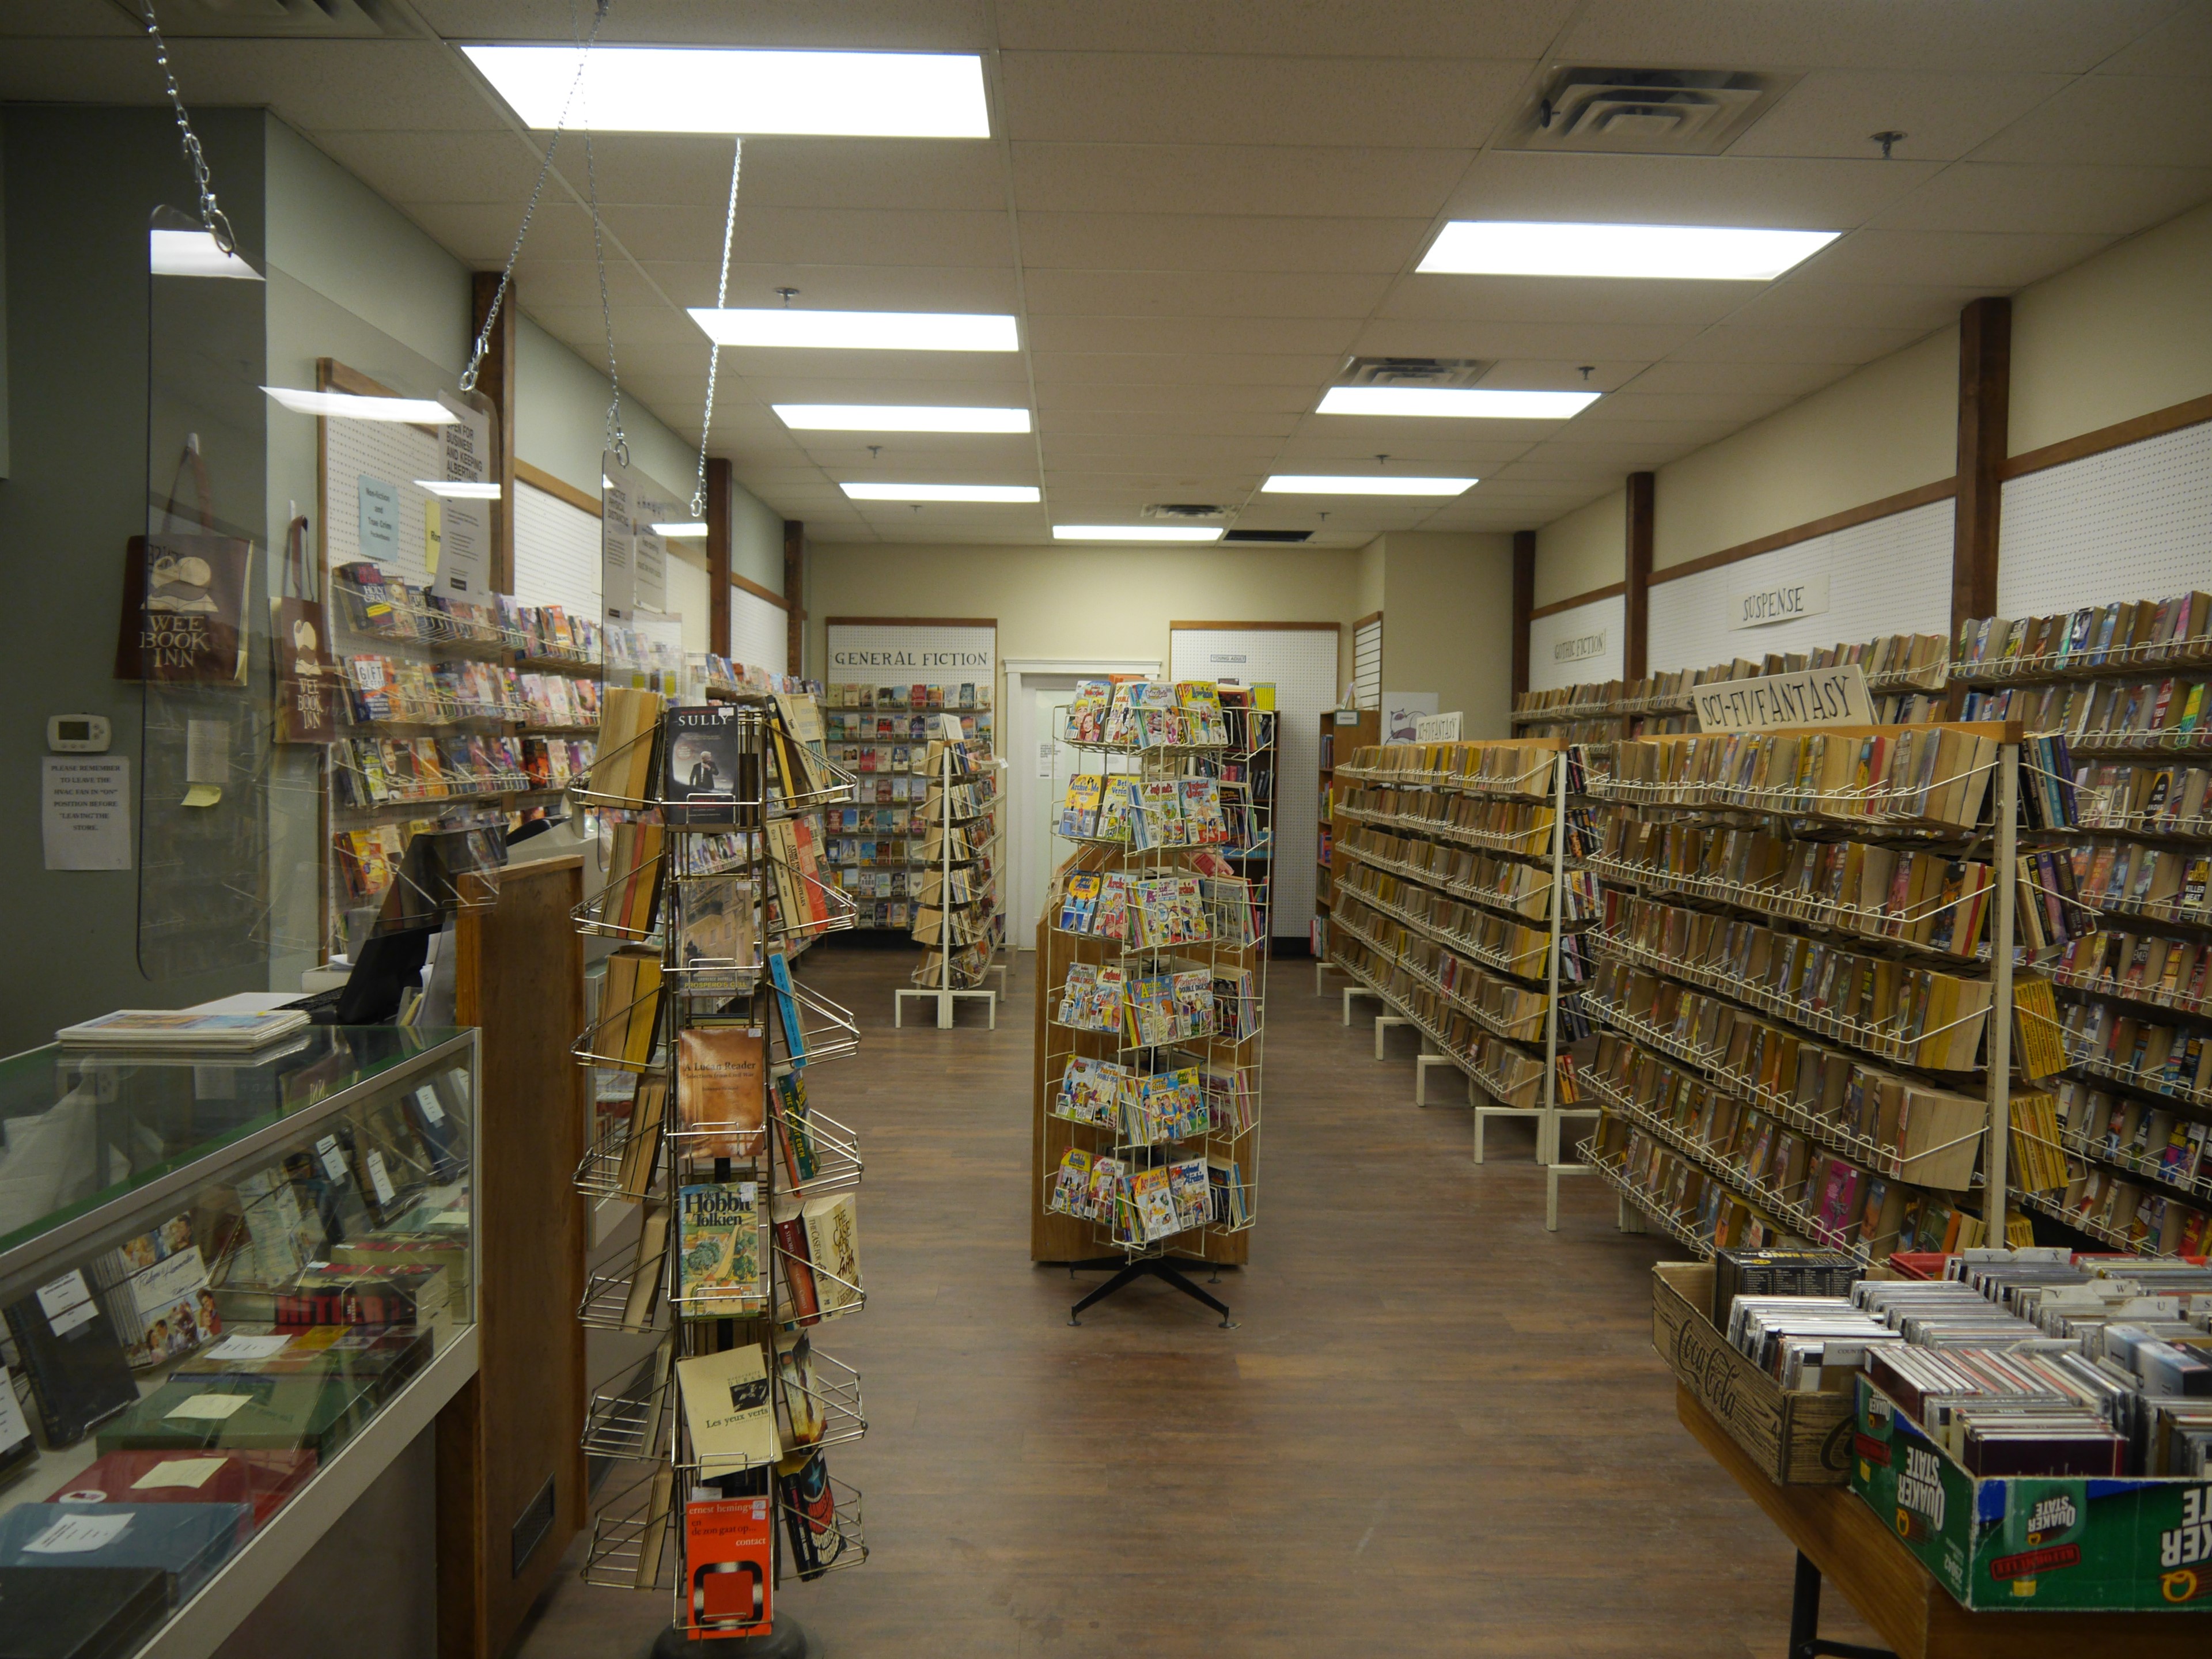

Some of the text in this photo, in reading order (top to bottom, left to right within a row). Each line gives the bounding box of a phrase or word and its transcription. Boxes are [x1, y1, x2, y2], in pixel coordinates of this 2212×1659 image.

[446, 431, 474, 453] BUSINESS
[460, 452, 483, 472] KEEPING
[447, 462, 478, 482] ALBERTANS
[363, 585, 384, 594] HOLY
[1743, 586, 1804, 622] SUSPENSE
[147, 615, 204, 632] WEE
[139, 631, 211, 650] BOOK
[1555, 634, 1603, 661] GOTHIC FICTION
[154, 648, 194, 668] INN
[835, 651, 987, 665] GENERAL FICTION
[359, 666, 381, 680] GIFT
[297, 694, 324, 712] BOOK
[1702, 675, 1853, 727] SCI-FI/FANTASY
[303, 711, 321, 729] INN
[679, 715, 729, 726] SULLY
[1071, 782, 1099, 793] Archie Me
[1179, 882, 1195, 894] rchie
[2185, 885, 2206, 893] KILLER
[1179, 984, 1194, 993] DOUBLE
[684, 1061, 756, 1071] A Lucan Reader
[785, 1091, 805, 1158] THE EDEN
[684, 1192, 752, 1214] Hobbit
[704, 1191, 714, 1199] de
[694, 1212, 743, 1227] Tolkien
[833, 1209, 847, 1227] THE
[785, 1230, 795, 1253] STROBEL
[811, 1230, 821, 1247] CASE
[833, 1221, 851, 1247] CASE
[838, 1240, 850, 1258] FOR
[2051, 1252, 2059, 1261] X
[837, 1249, 855, 1278] faith
[1986, 1255, 1993, 1263] Y
[2053, 1290, 2062, 1299] V
[2116, 1285, 2127, 1294] W
[277, 1295, 401, 1324] HITLER
[2157, 1302, 2166, 1311] U
[2204, 1301, 2211, 1309] S
[1678, 1319, 1741, 1421] Coca-Cola
[728, 1374, 762, 1386] DURAS
[706, 1419, 722, 1429] Les
[725, 1414, 745, 1427] yeux
[748, 1407, 768, 1418] verts
[1869, 1397, 1891, 1422] QUAKER
[1906, 1445, 1940, 1487] STATE
[689, 1502, 753, 1514] ernest hemingw
[1897, 1473, 1946, 1532] QUAKER
[2035, 1495, 2070, 1515] STATE
[2027, 1504, 2076, 1533] QUAKER
[692, 1527, 701, 1536] de
[719, 1527, 736, 1536] gaat
[736, 1537, 766, 1546] contact
[2161, 1522, 2212, 1567] KER
